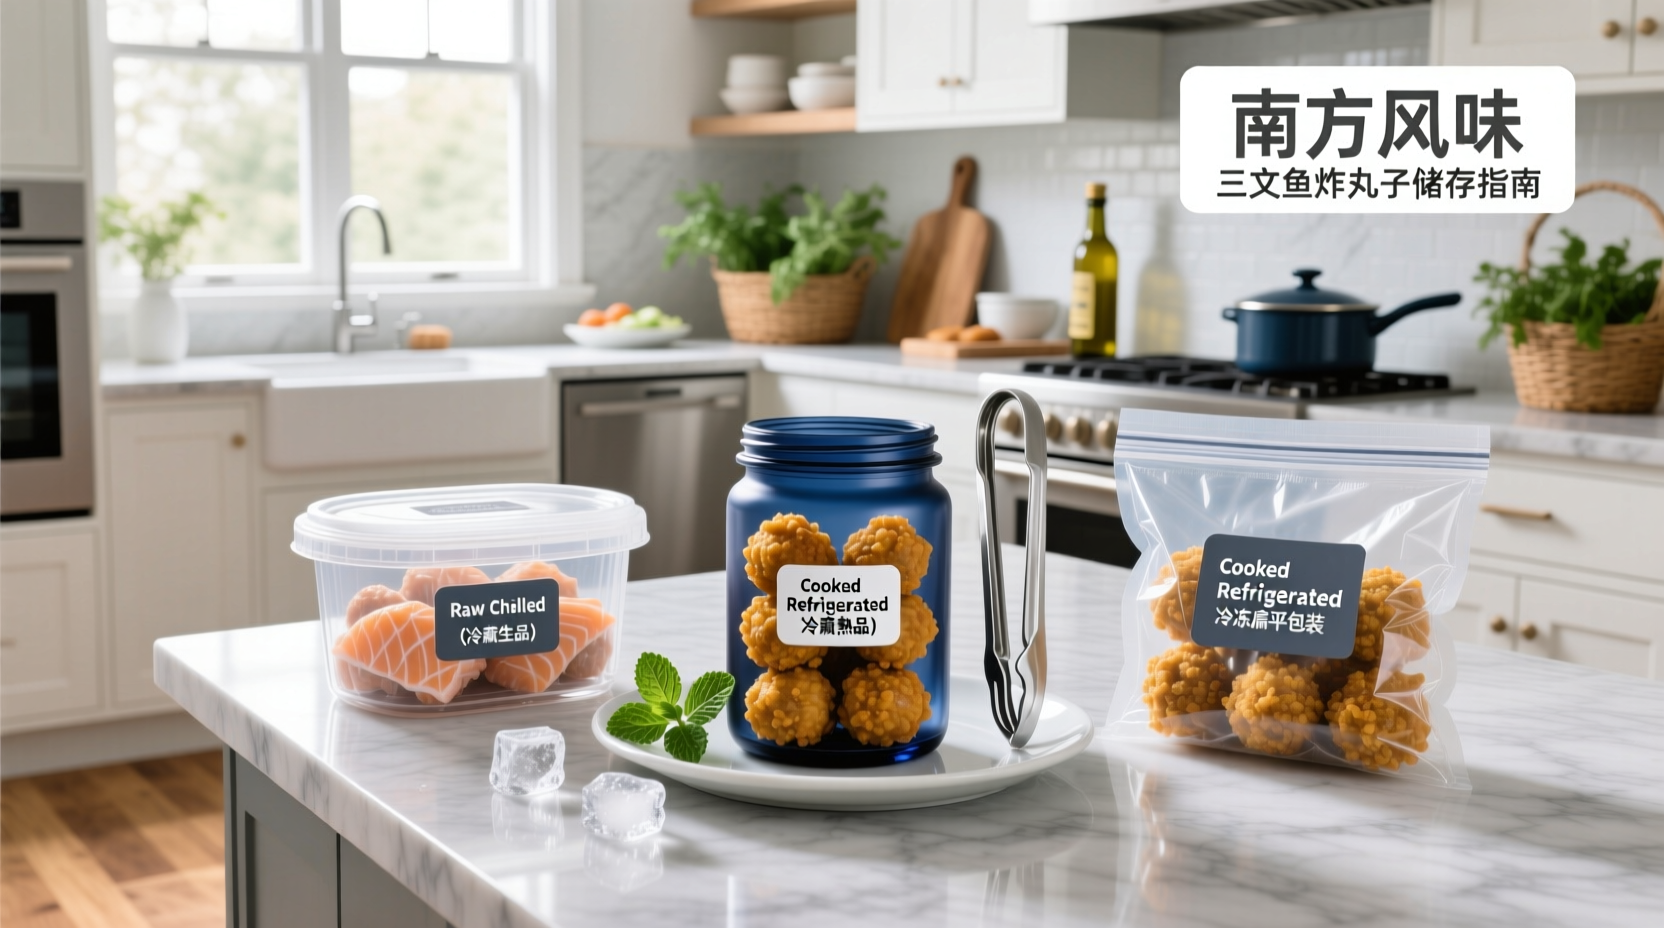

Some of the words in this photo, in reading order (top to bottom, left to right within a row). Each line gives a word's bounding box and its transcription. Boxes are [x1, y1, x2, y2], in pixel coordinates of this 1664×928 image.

[1219, 557, 1291, 579] Cooked
[800, 577, 861, 593] Cooked
[1216, 582, 1344, 608] Refrigerated
[450, 602, 485, 618] Raw
[489, 596, 546, 615] Chilled
[787, 596, 889, 616] Refrigerated
